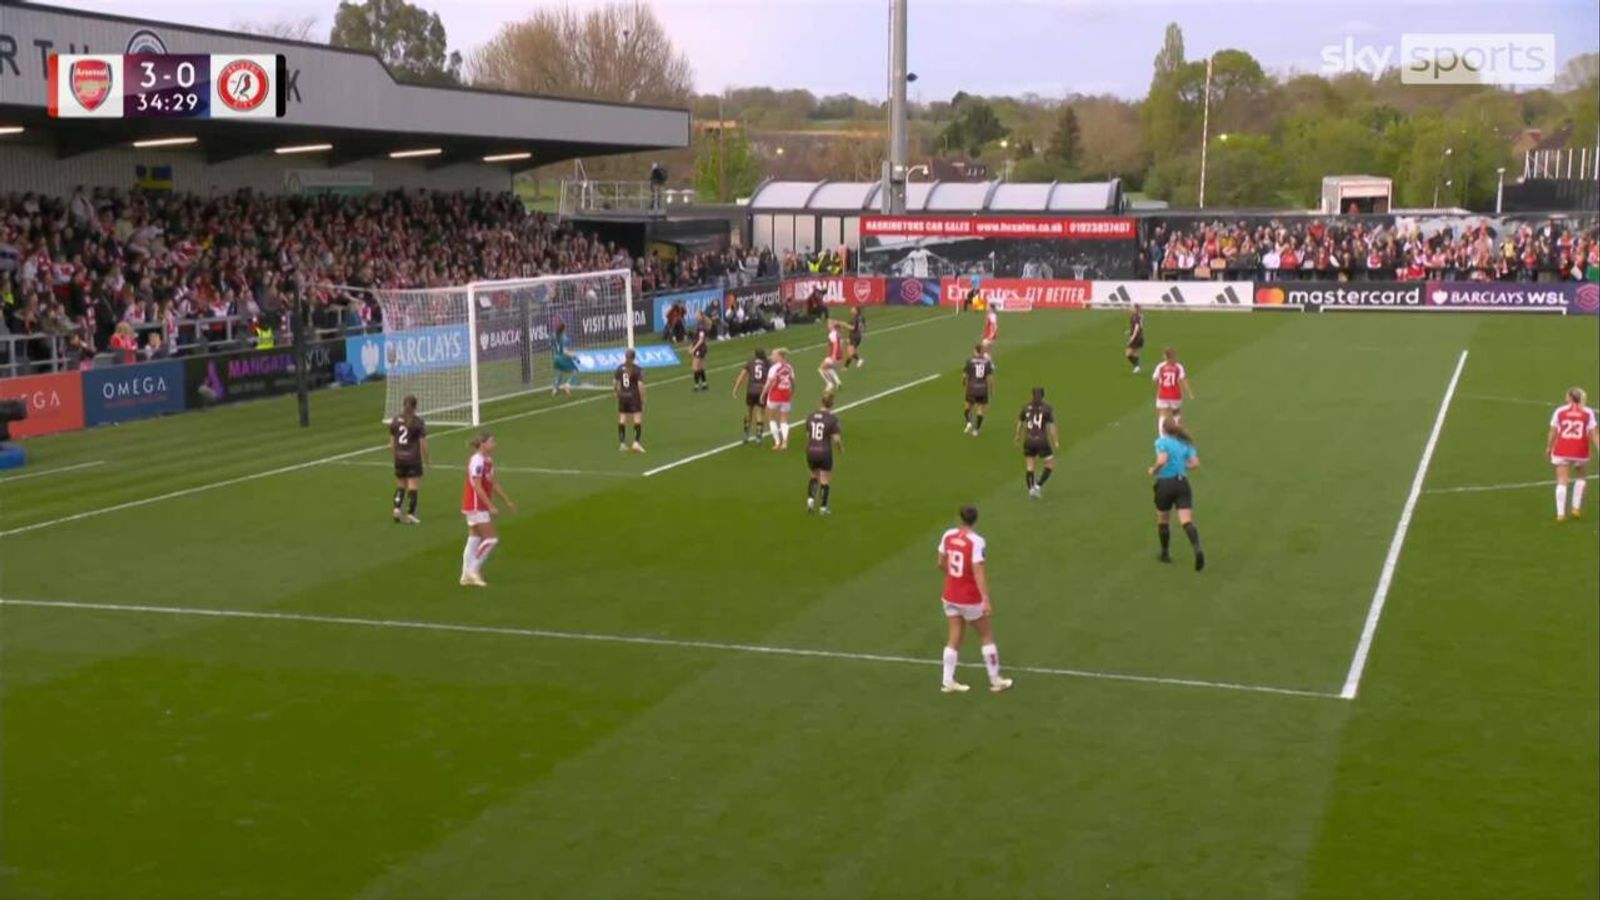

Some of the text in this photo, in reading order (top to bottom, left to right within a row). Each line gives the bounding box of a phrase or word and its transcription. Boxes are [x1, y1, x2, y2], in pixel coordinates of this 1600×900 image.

[925, 221, 943, 231] CAR
[944, 221, 970, 232] SALES
[1045, 287, 1085, 303] BETTER
[1288, 287, 1419, 305] mastercard
[1451, 291, 1569, 305] BARCLAYS WSL
[583, 310, 647, 334] VISIT RWADA
[490, 325, 549, 348] BARCLA WSL
[754, 365, 762, 379] 5
[1162, 372, 1176, 386] 21
[103, 376, 166, 399] OMEGA
[398, 426, 408, 444] 2
[811, 422, 824, 440] 16
[1561, 419, 1584, 439] 23
